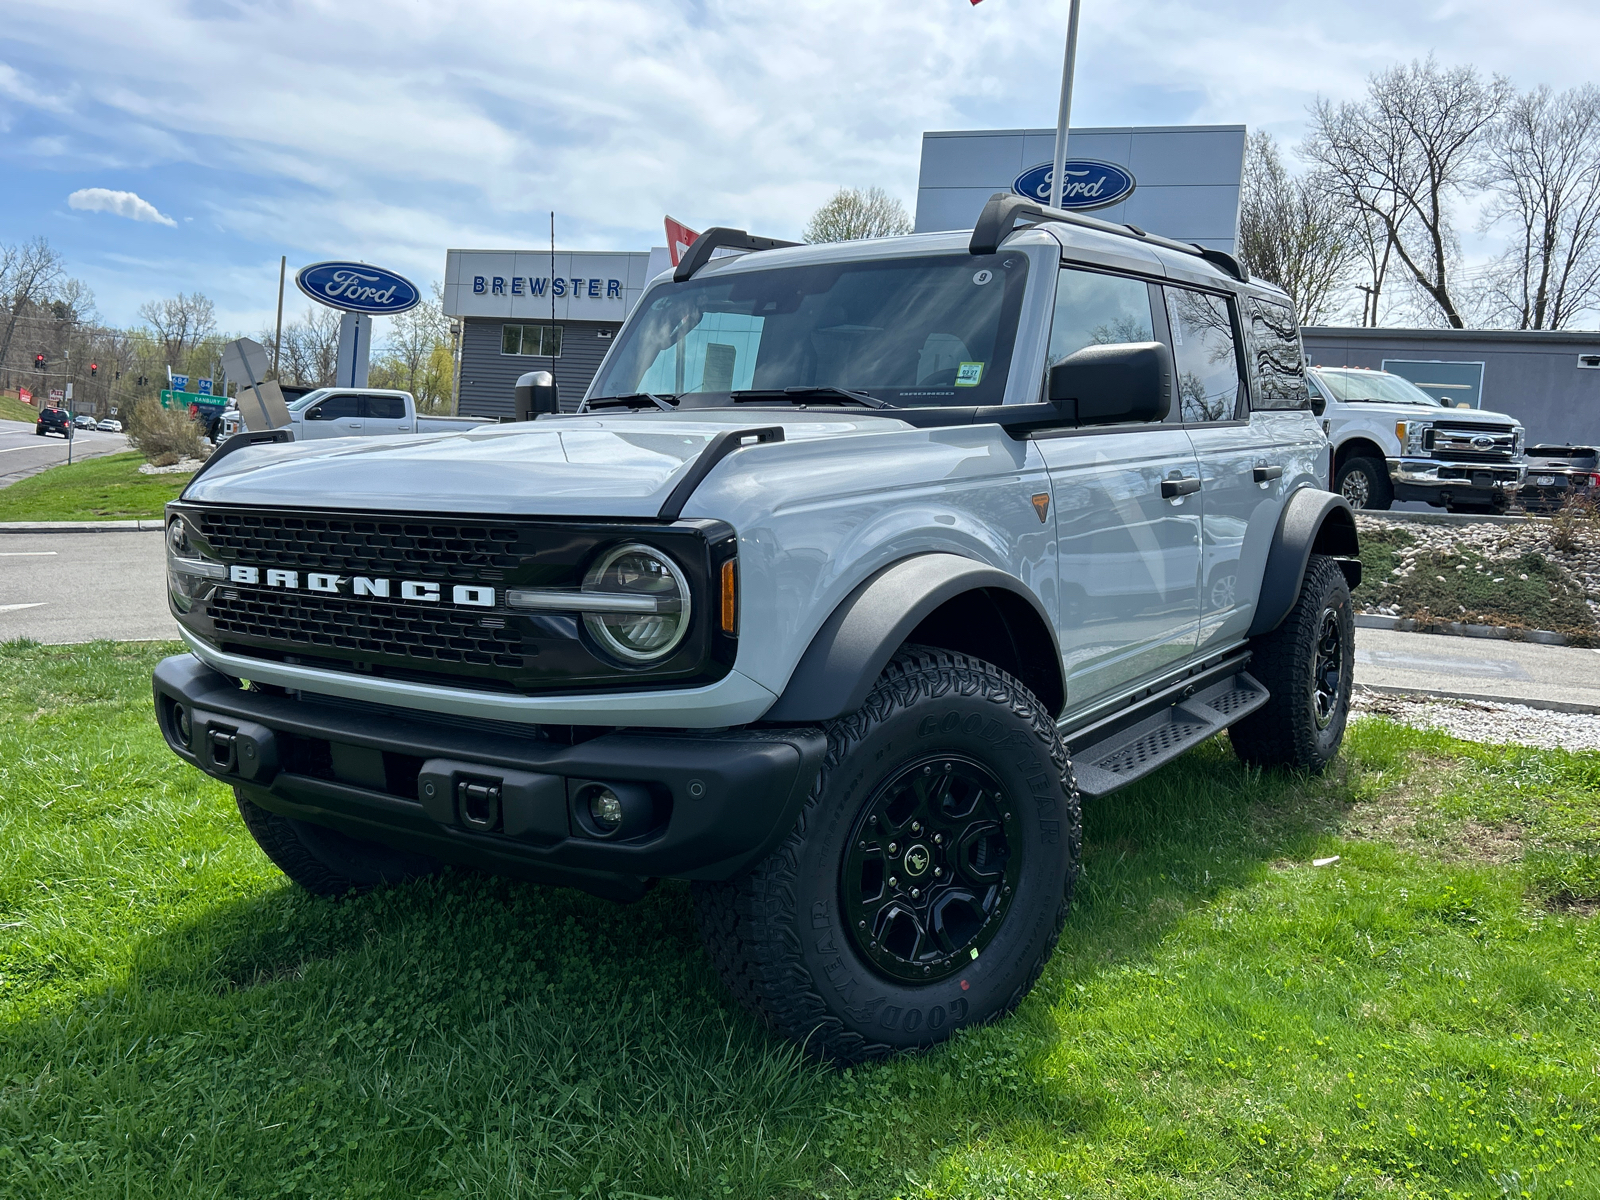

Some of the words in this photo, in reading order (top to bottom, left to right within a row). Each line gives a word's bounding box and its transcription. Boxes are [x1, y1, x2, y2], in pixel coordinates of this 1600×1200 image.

[1036, 170, 1107, 198] Ford
[325, 270, 397, 305] Ford
[473, 275, 622, 298] BREWSTER
[978, 272, 988, 282] 9
[194, 396, 221, 405] DANBURY
[229, 564, 496, 608] BRONCO
[917, 710, 1060, 845] GOODYEAR
[811, 900, 970, 1033] GOODYEAR
